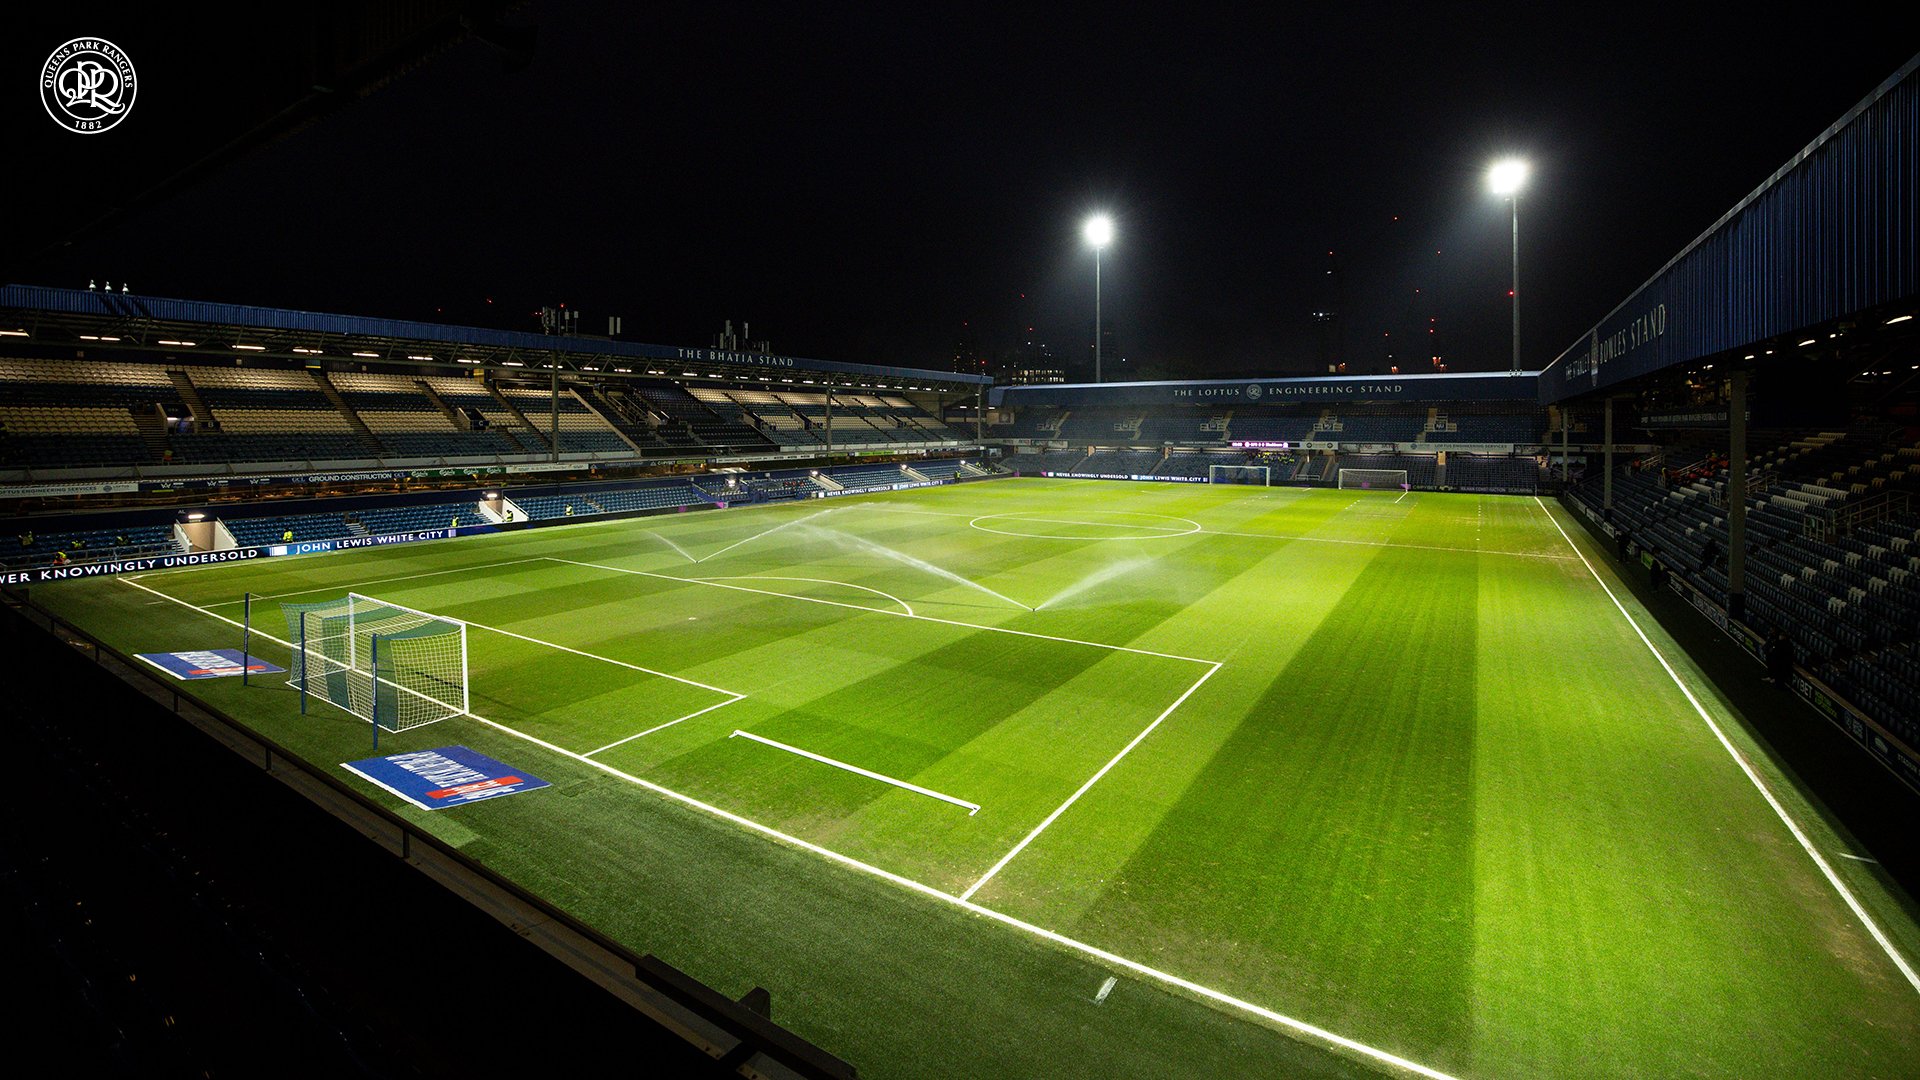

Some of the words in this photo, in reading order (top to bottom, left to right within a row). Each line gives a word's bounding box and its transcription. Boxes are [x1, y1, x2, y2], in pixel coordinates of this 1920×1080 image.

[1631, 303, 1666, 350] STAND
[678, 348, 702, 359] THE
[709, 351, 753, 363] BHATIA
[759, 355, 794, 366] STAND
[1198, 388, 1240, 396] LOFTUS
[1269, 385, 1353, 395] ENGINEERING
[1360, 385, 1402, 393] STAND
[308, 475, 340, 483] GROUND
[340, 473, 392, 482] CONSTRUCTION
[295, 541, 331, 555] JOHN
[336, 537, 372, 549] LEWIS
[377, 533, 414, 544] WHITE
[418, 530, 443, 540] CITY
[41, 559, 156, 580] KNOWINGLY
[164, 549, 258, 567] UNDERSOLD
